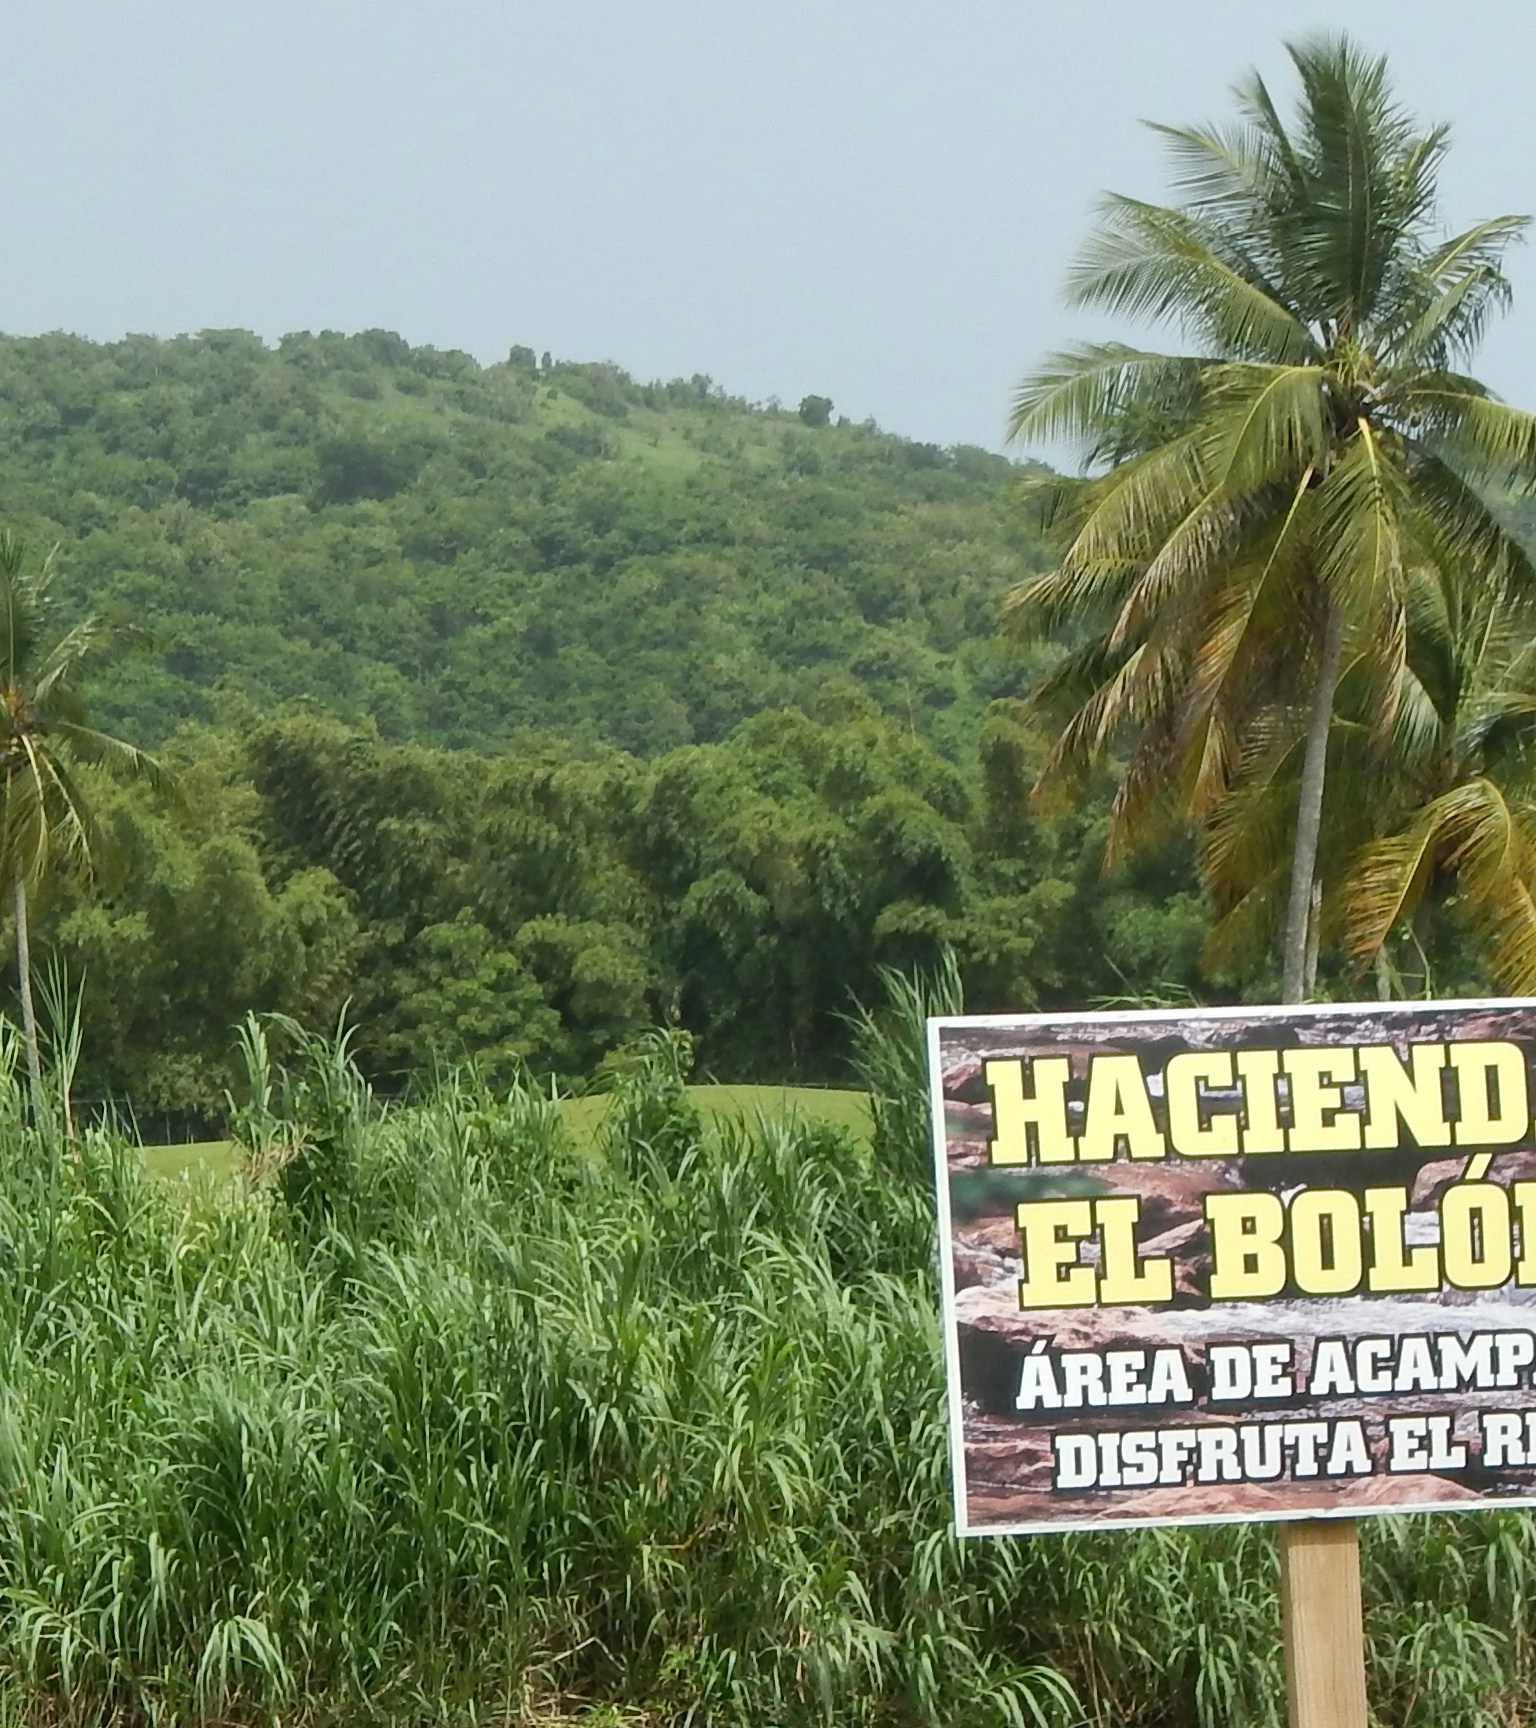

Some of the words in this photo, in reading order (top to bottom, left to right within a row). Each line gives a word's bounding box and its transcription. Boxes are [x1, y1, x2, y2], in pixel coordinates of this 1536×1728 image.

[1017, 1197, 1173, 1307] EL
[1015, 1340, 1193, 1410] ÁREA
[1210, 1343, 1292, 1401] DE
[1054, 1420, 1372, 1490] DISFRUTA
[1389, 1416, 1466, 1471] EL
